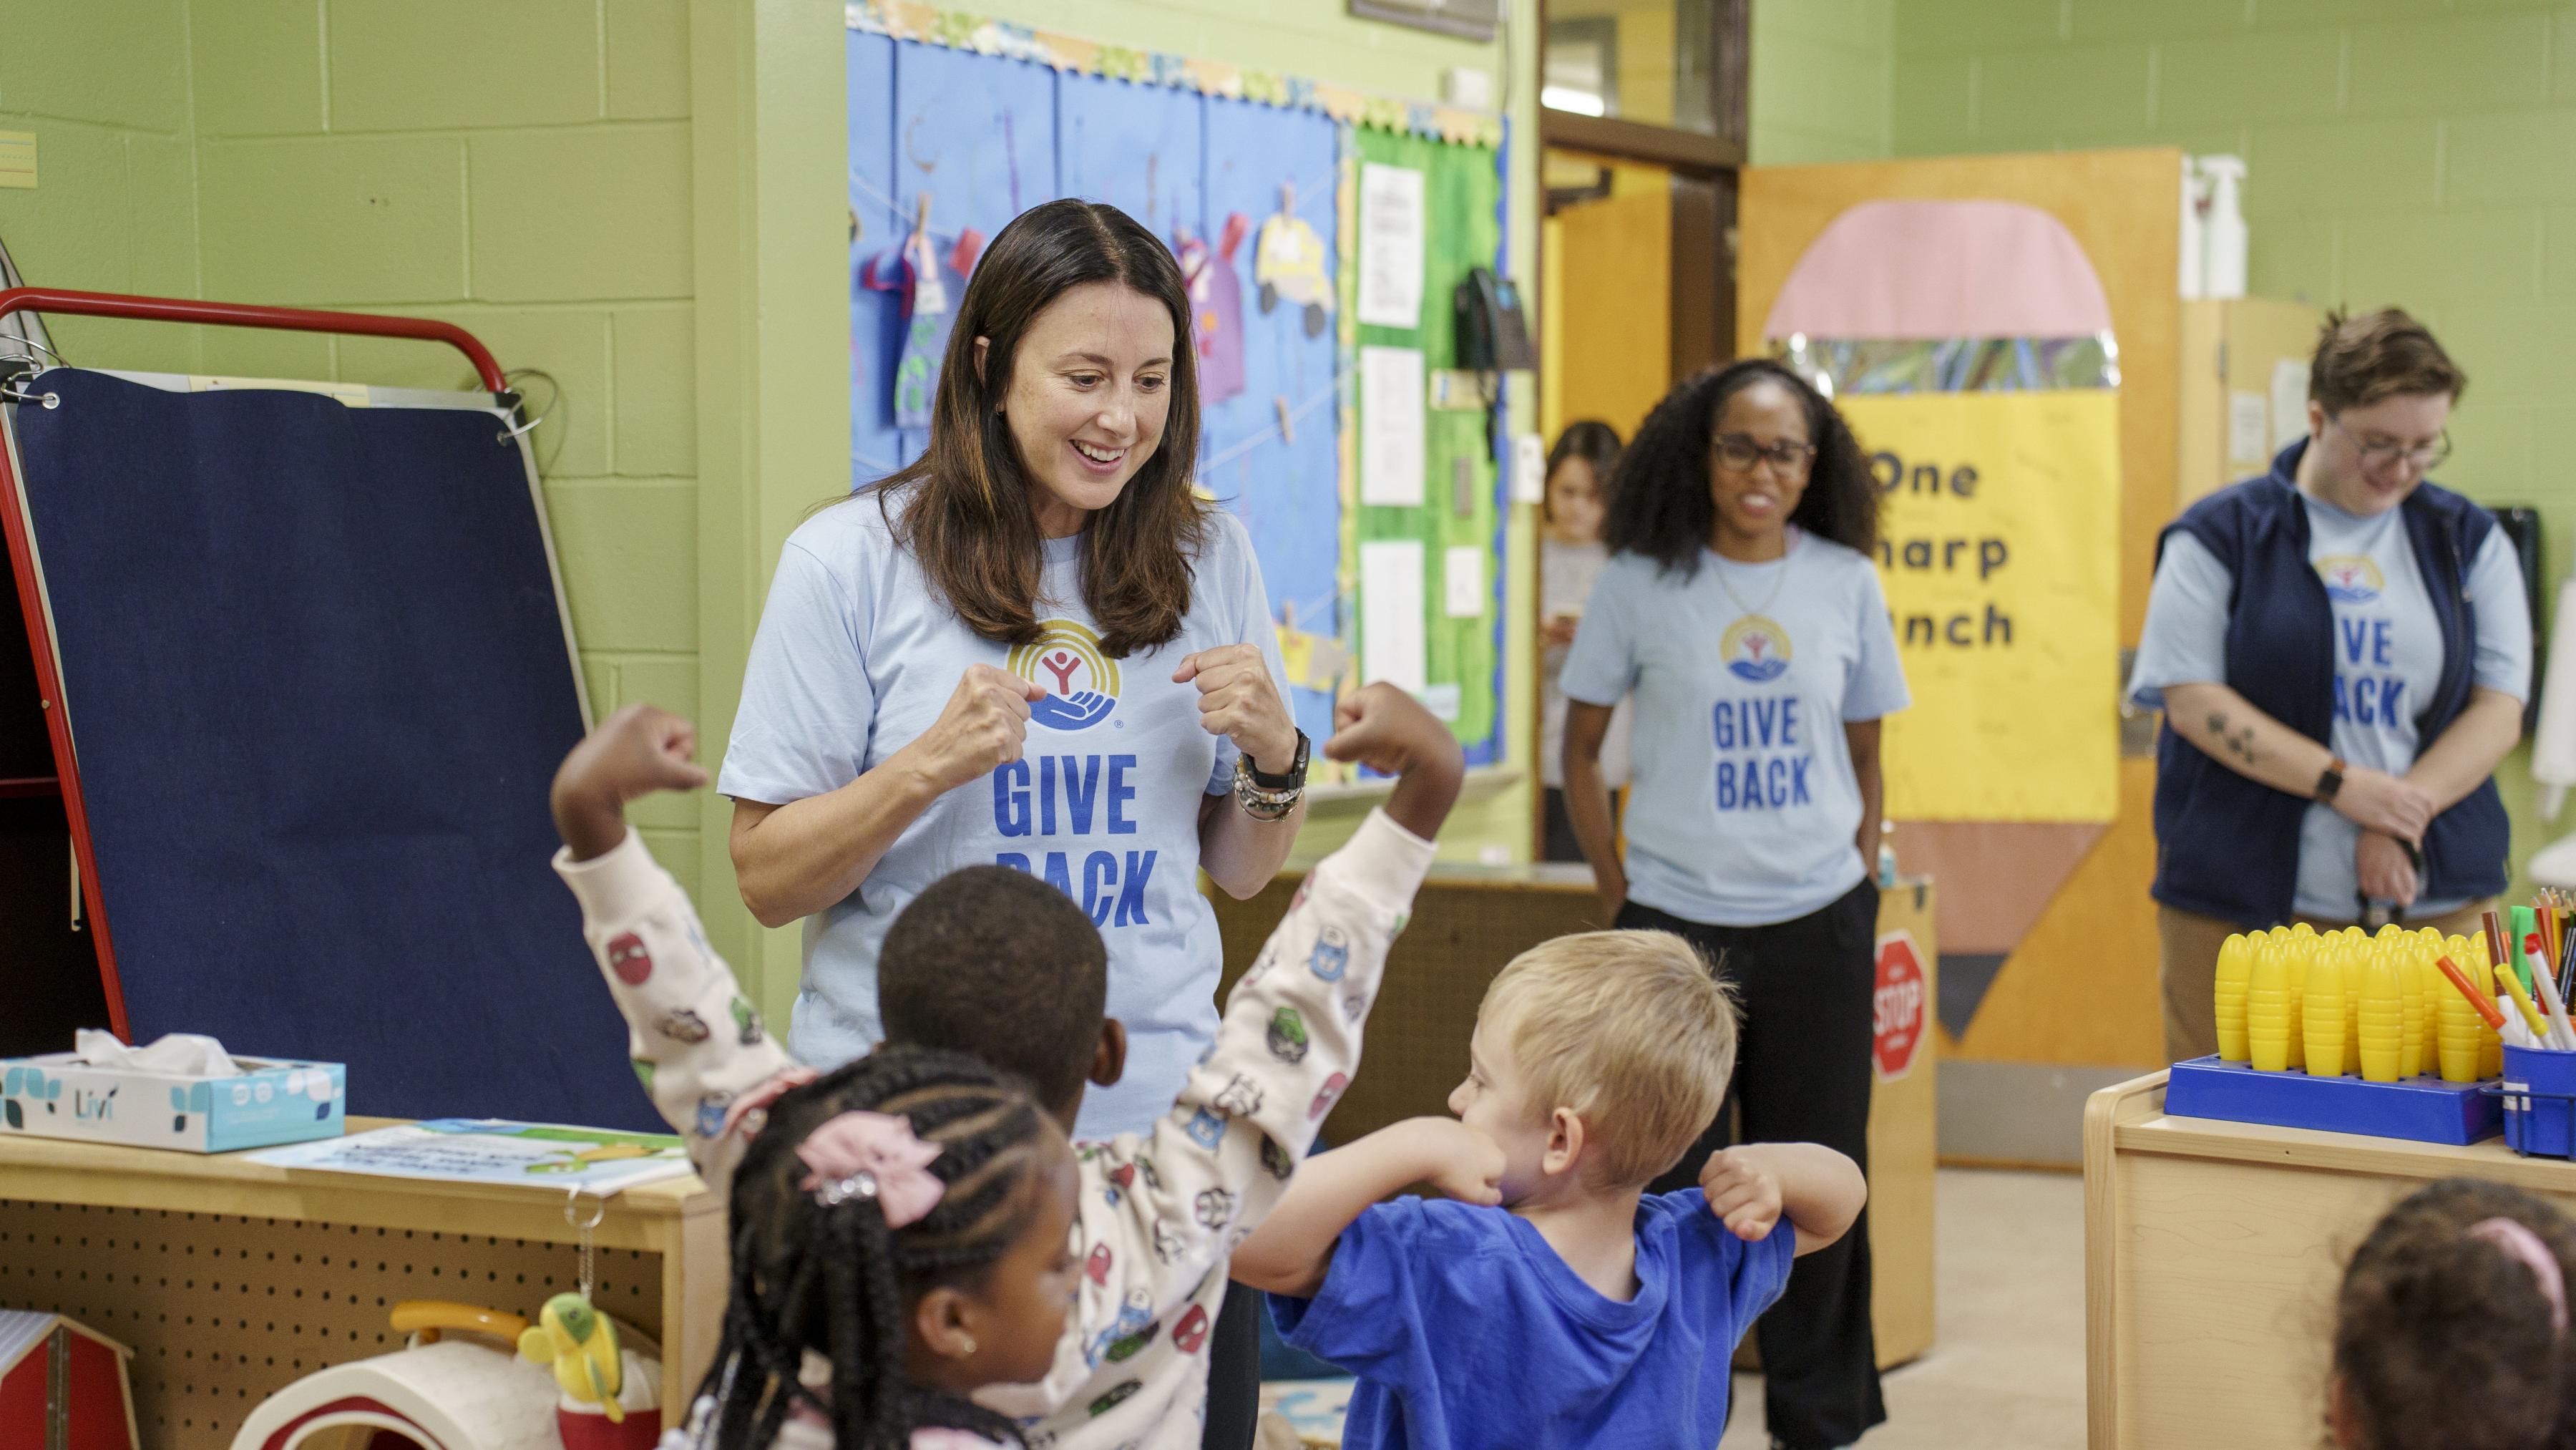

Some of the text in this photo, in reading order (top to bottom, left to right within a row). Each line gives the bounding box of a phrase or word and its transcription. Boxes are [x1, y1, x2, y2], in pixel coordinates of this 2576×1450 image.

[1867, 451, 1978, 496] One
[1714, 696, 1798, 749] GIVE
[2331, 674, 2405, 729] ACK
[993, 754, 1136, 837] GIVE
[1718, 756, 1811, 809] BACK
[996, 850, 1158, 928] ACK
[1873, 978, 1918, 1035] STOP
[75, 1085, 117, 1121] Livi
